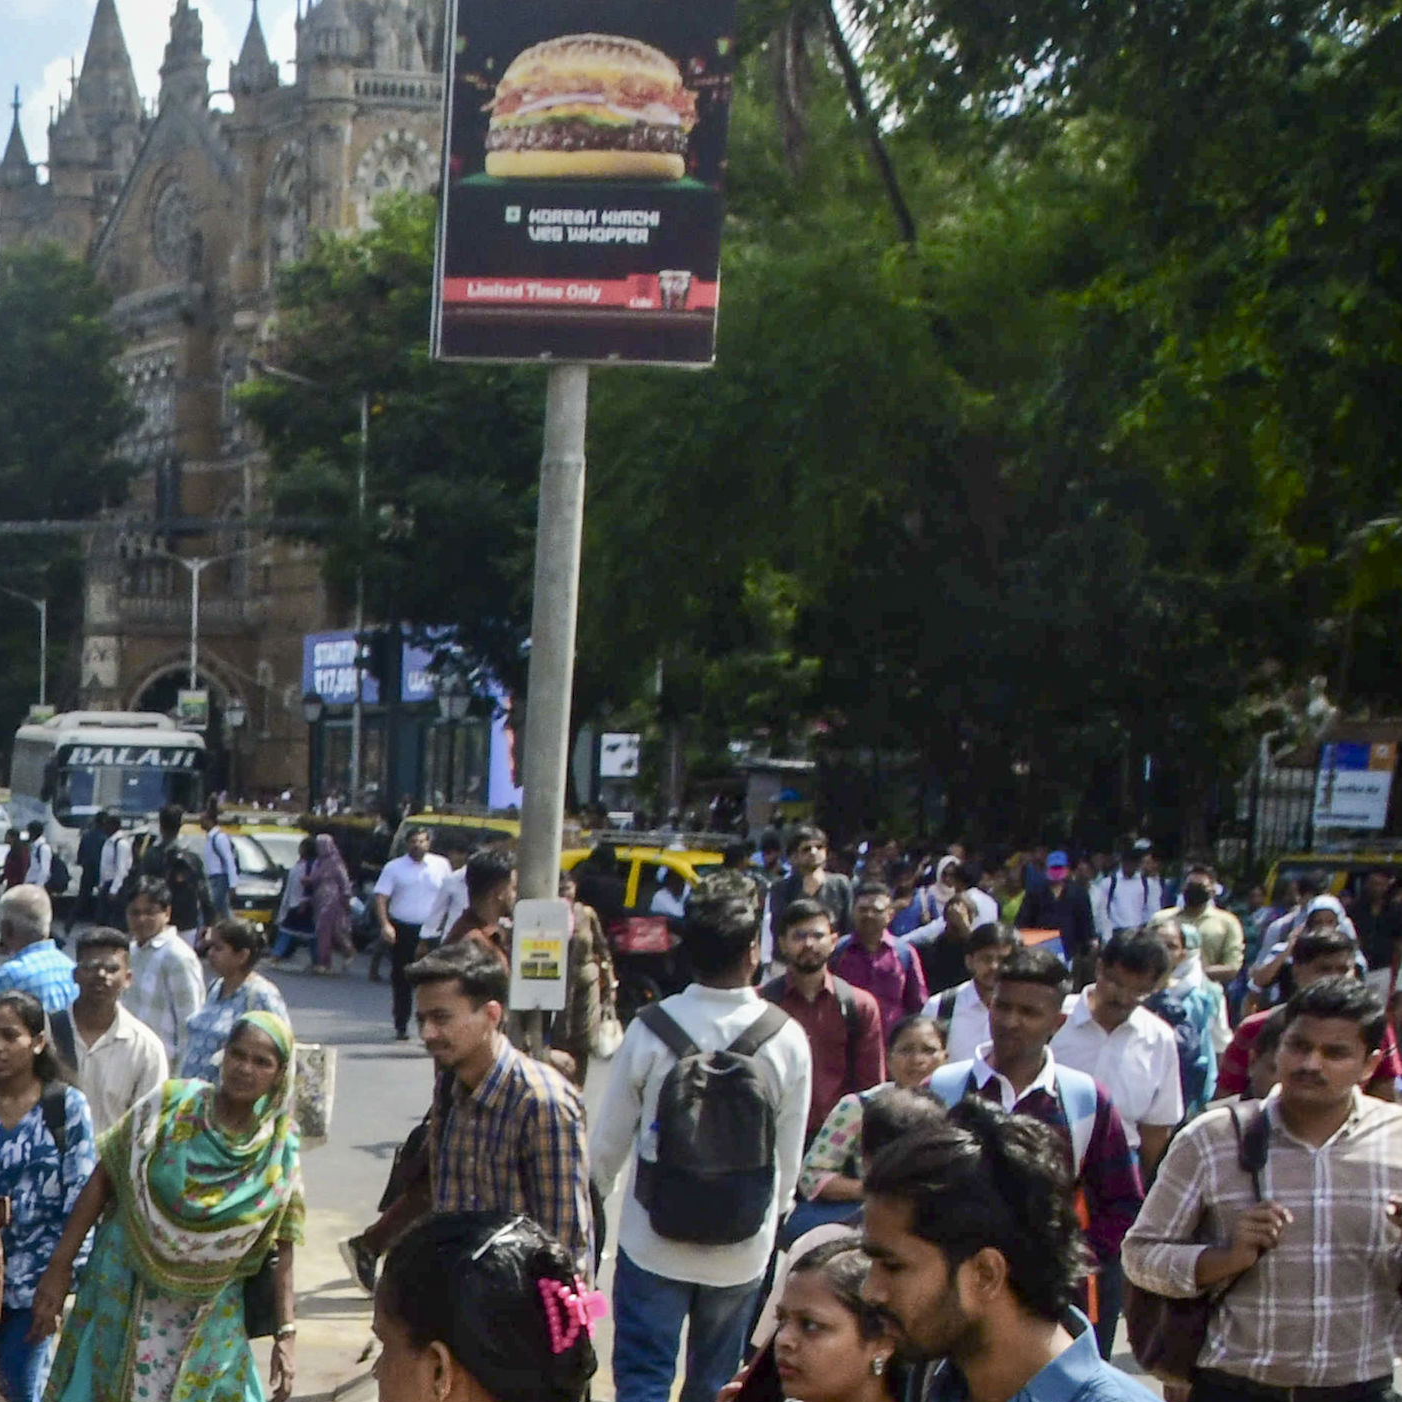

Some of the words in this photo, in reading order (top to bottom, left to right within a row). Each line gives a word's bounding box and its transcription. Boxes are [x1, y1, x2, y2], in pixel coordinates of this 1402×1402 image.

[528, 225, 563, 242] VEG
[567, 227, 649, 244] WHOPPER
[467, 282, 523, 299] Limited
[527, 282, 563, 299] Time
[566, 283, 602, 304] Only
